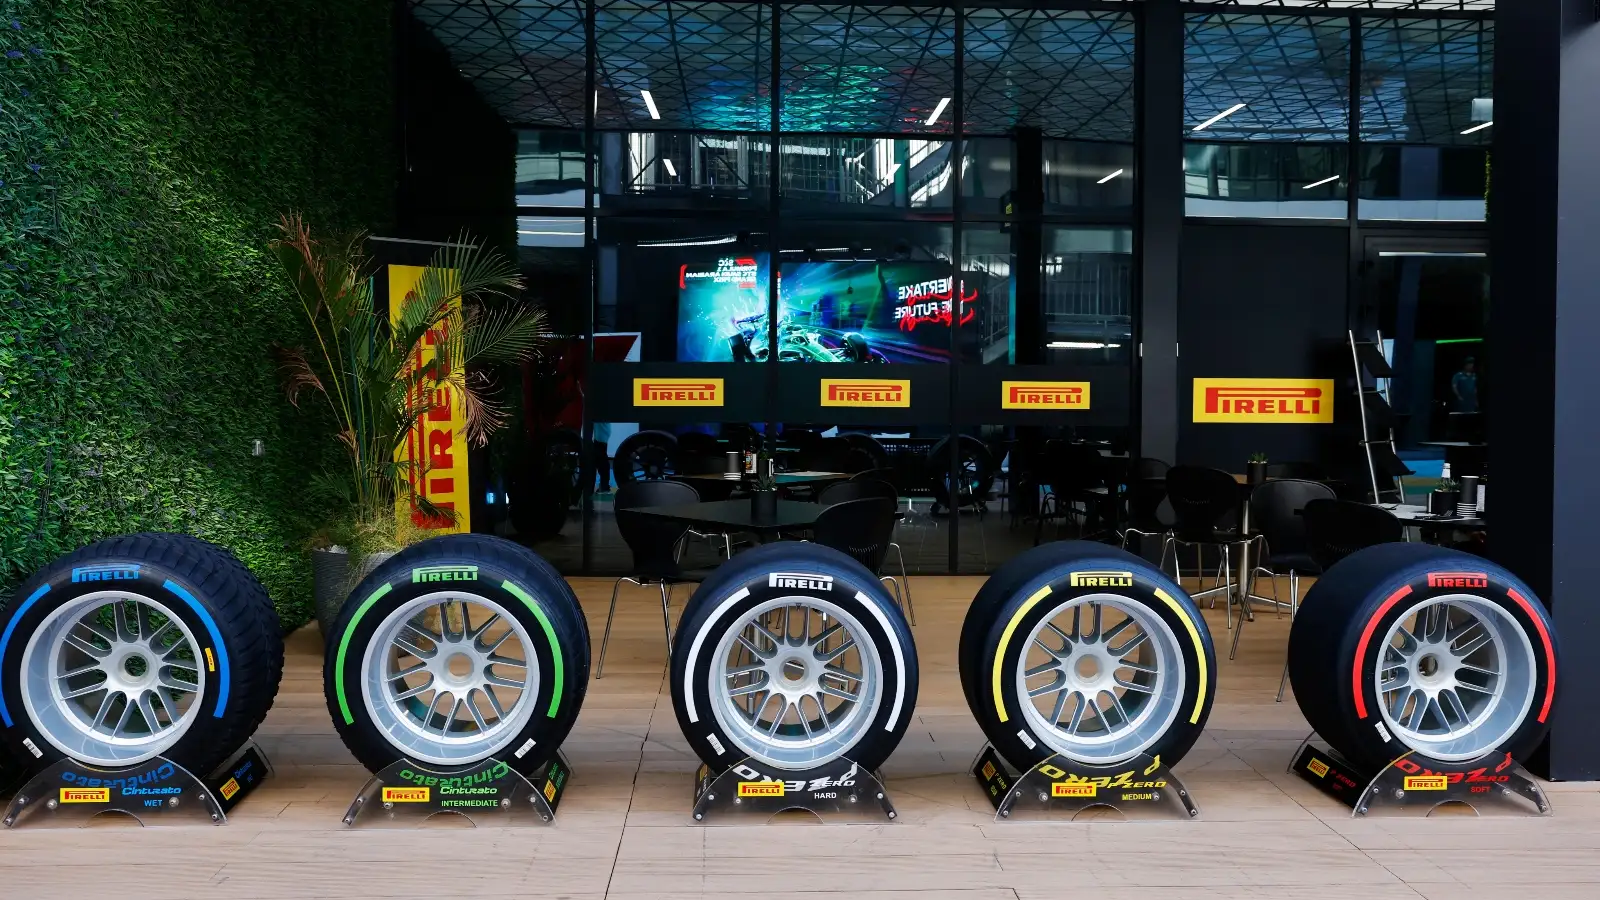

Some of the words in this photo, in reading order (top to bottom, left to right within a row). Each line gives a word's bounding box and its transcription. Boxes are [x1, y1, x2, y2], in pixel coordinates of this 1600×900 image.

[641, 384, 716, 401] PIRELLI
[828, 384, 902, 401] PIRELLI
[1009, 386, 1082, 404] PIRELLI
[1205, 387, 1322, 414] PIRELLI
[71, 564, 141, 583] PIRELLI
[412, 565, 479, 583] PIRELLI
[768, 572, 834, 591] PIRELLI
[1070, 571, 1133, 587] PIRELLI
[1427, 572, 1488, 588] PIRELLI
[742, 784, 780, 794] PIRELLI
[1055, 785, 1093, 795] PIRELLI
[1408, 778, 1444, 788] PIRELLI
[1470, 785, 1492, 793] SOFT
[64, 791, 105, 800] PIRELLI
[386, 790, 426, 800] PIRELLI
[1121, 793, 1152, 801] MEDIUM
